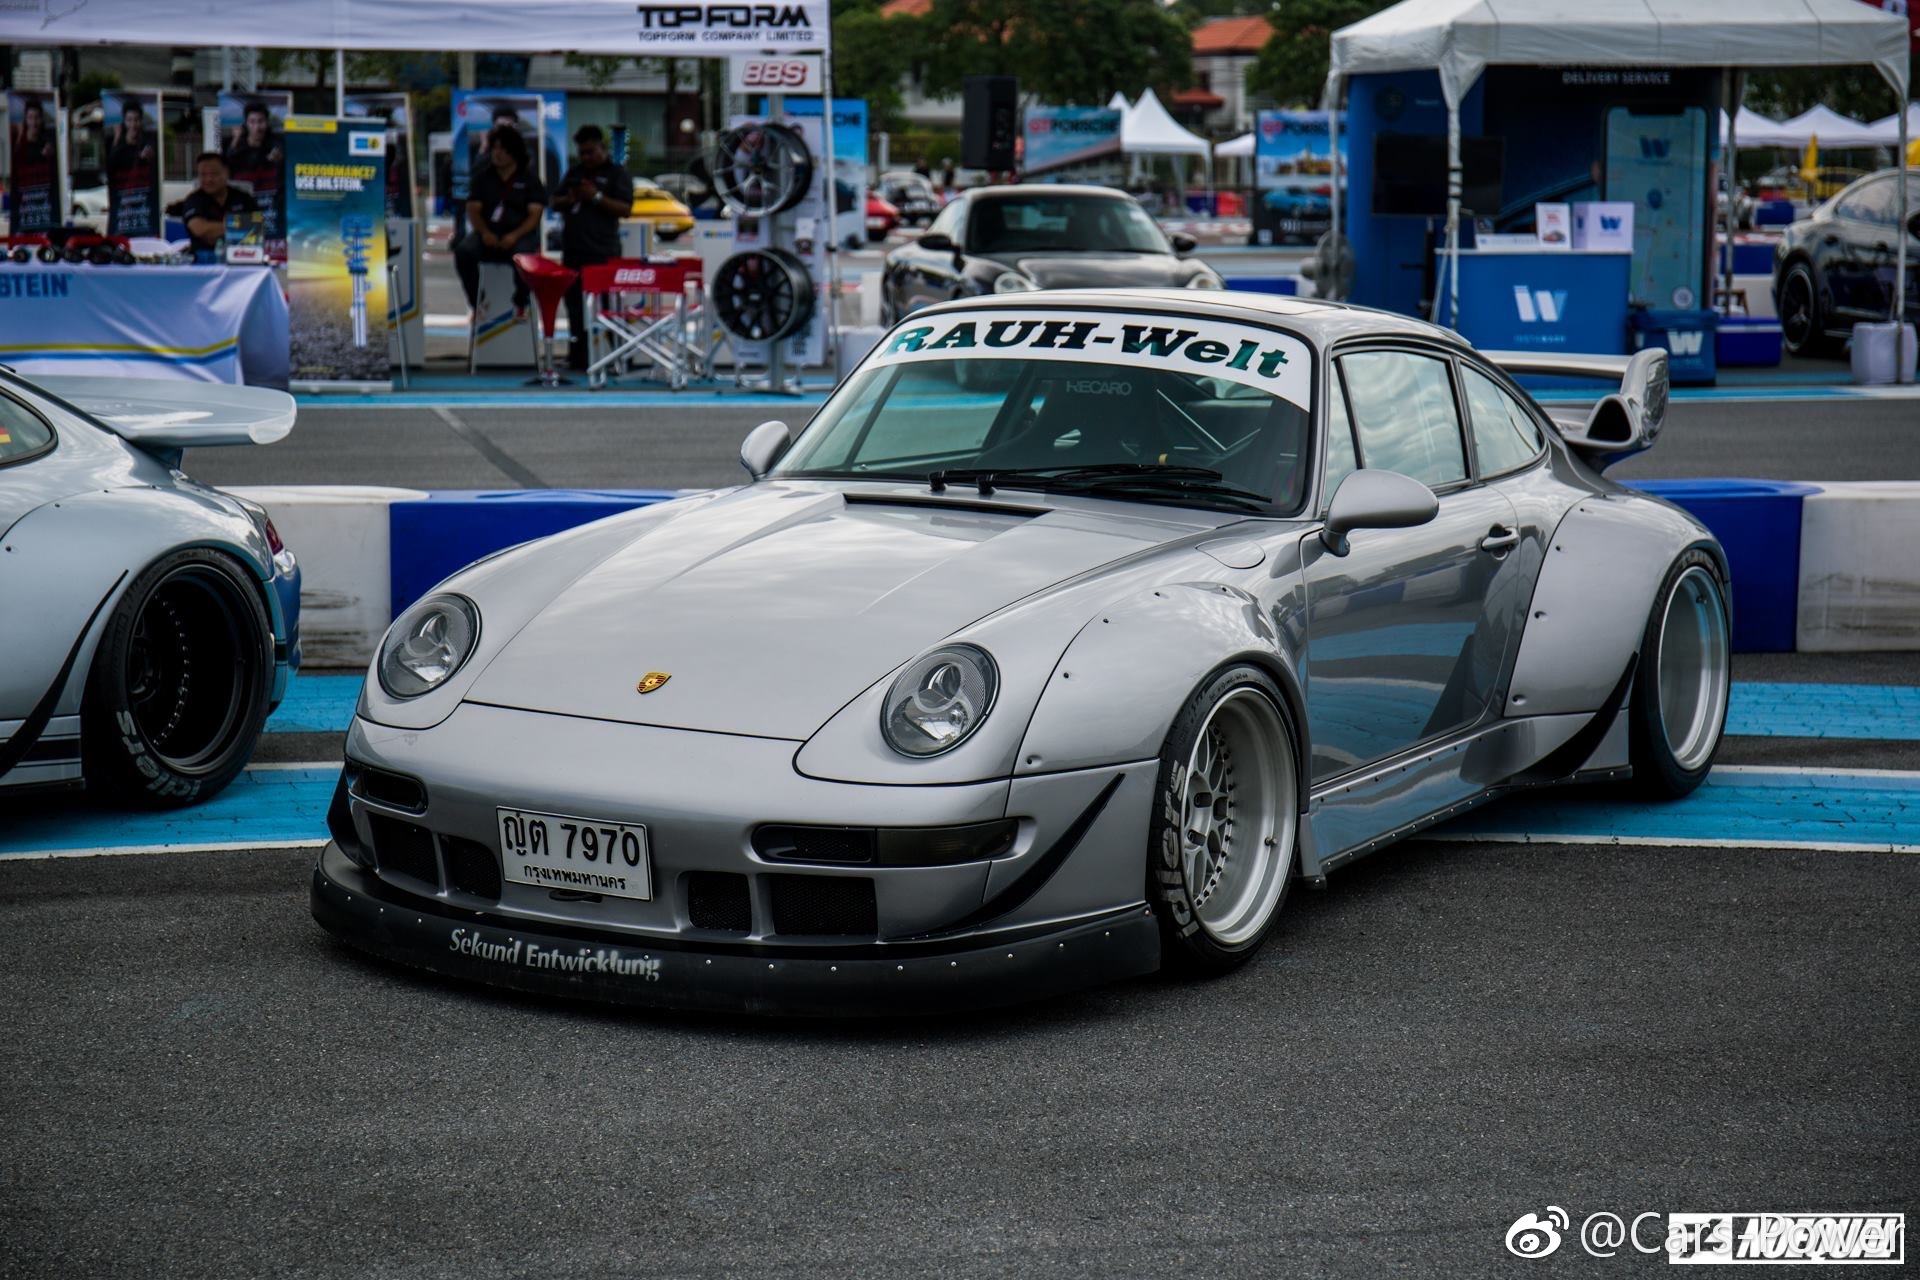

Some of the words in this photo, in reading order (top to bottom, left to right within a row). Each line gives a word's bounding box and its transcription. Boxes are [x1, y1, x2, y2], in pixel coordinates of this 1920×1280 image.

[638, 31, 697, 42] TOPFORM
[702, 31, 760, 42] COMPANY
[766, 31, 814, 42] LIMITED
[742, 60, 808, 86] BBS
[1562, 71, 1619, 85] DELIVERY
[1622, 71, 1672, 85] SERVICE
[614, 267, 656, 285] BBS
[882, 320, 1290, 379] RAUH-Welt
[560, 823, 641, 868] 7970
[523, 865, 627, 890] กรุงเทพมหานคร
[450, 928, 522, 965] Sekund
[526, 943, 662, 982] Entwicklung
